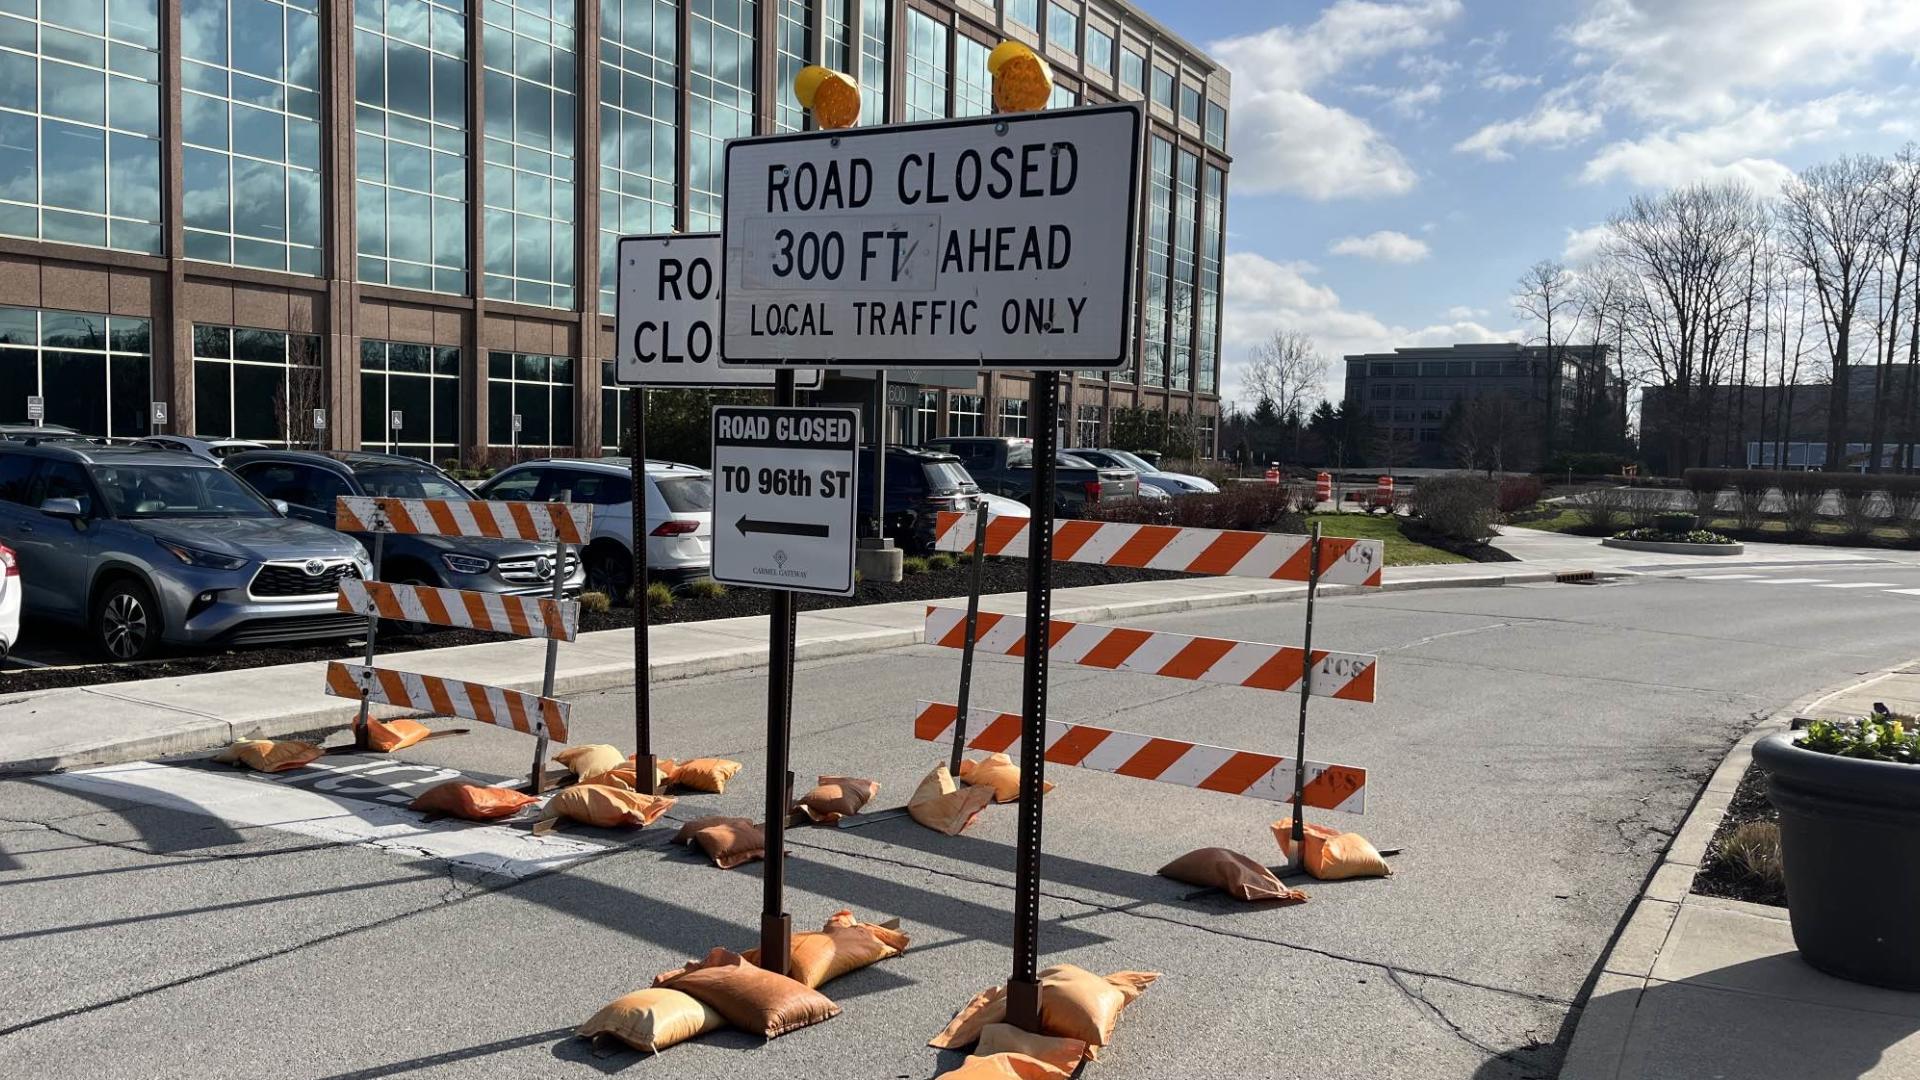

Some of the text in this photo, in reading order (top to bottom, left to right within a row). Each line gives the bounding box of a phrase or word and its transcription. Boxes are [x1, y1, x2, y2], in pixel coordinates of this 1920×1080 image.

[767, 141, 1078, 213] ROAD CLOSED
[772, 224, 1072, 283] 300 FT AHEAD
[658, 257, 720, 301] RO
[750, 297, 1088, 337] LOCAL TRAFFIC ONLY
[634, 320, 713, 364] CLO
[719, 415, 851, 443] ROAD CLOSED
[722, 465, 850, 499] TO 96th ST
[752, 567, 807, 579] CARMEL GATEWAY
